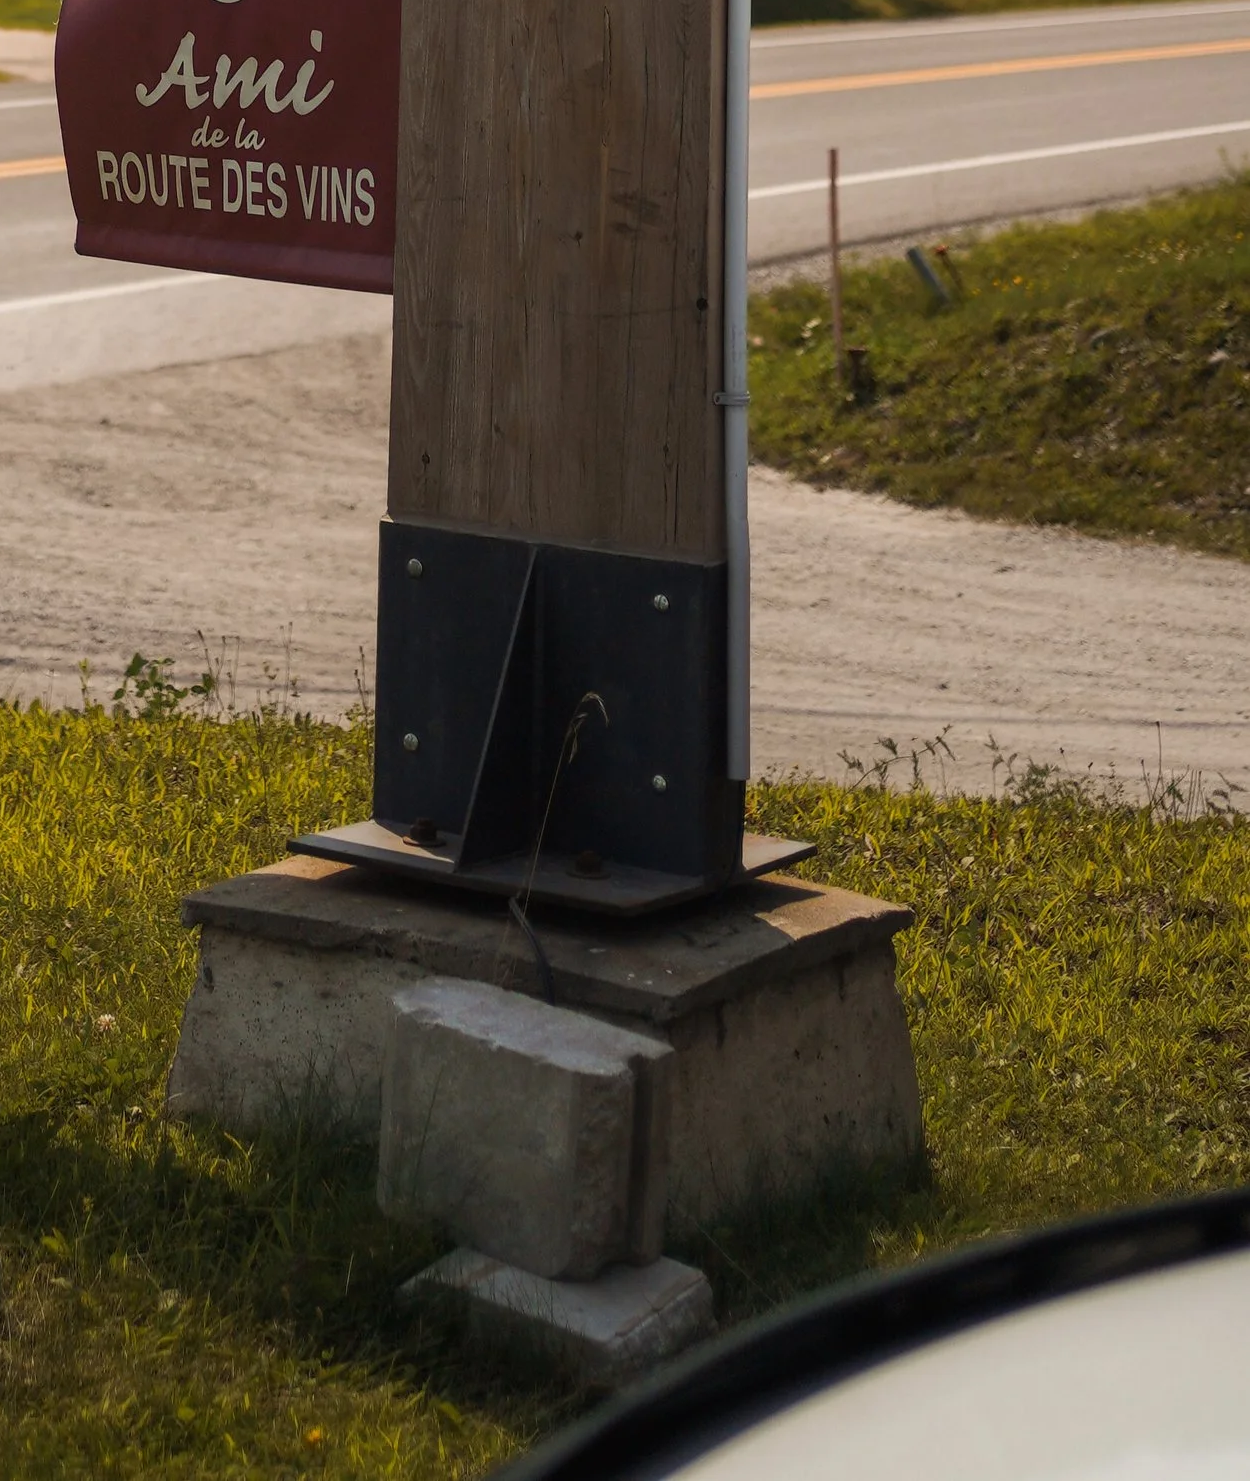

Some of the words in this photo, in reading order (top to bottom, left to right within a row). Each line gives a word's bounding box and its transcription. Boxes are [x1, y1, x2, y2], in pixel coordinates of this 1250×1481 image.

[135, 29, 335, 116] Ami
[191, 115, 230, 148] de
[234, 117, 266, 150] la
[96, 150, 212, 210] ROUTE
[222, 159, 288, 218] DES
[295, 165, 376, 226] VINS
